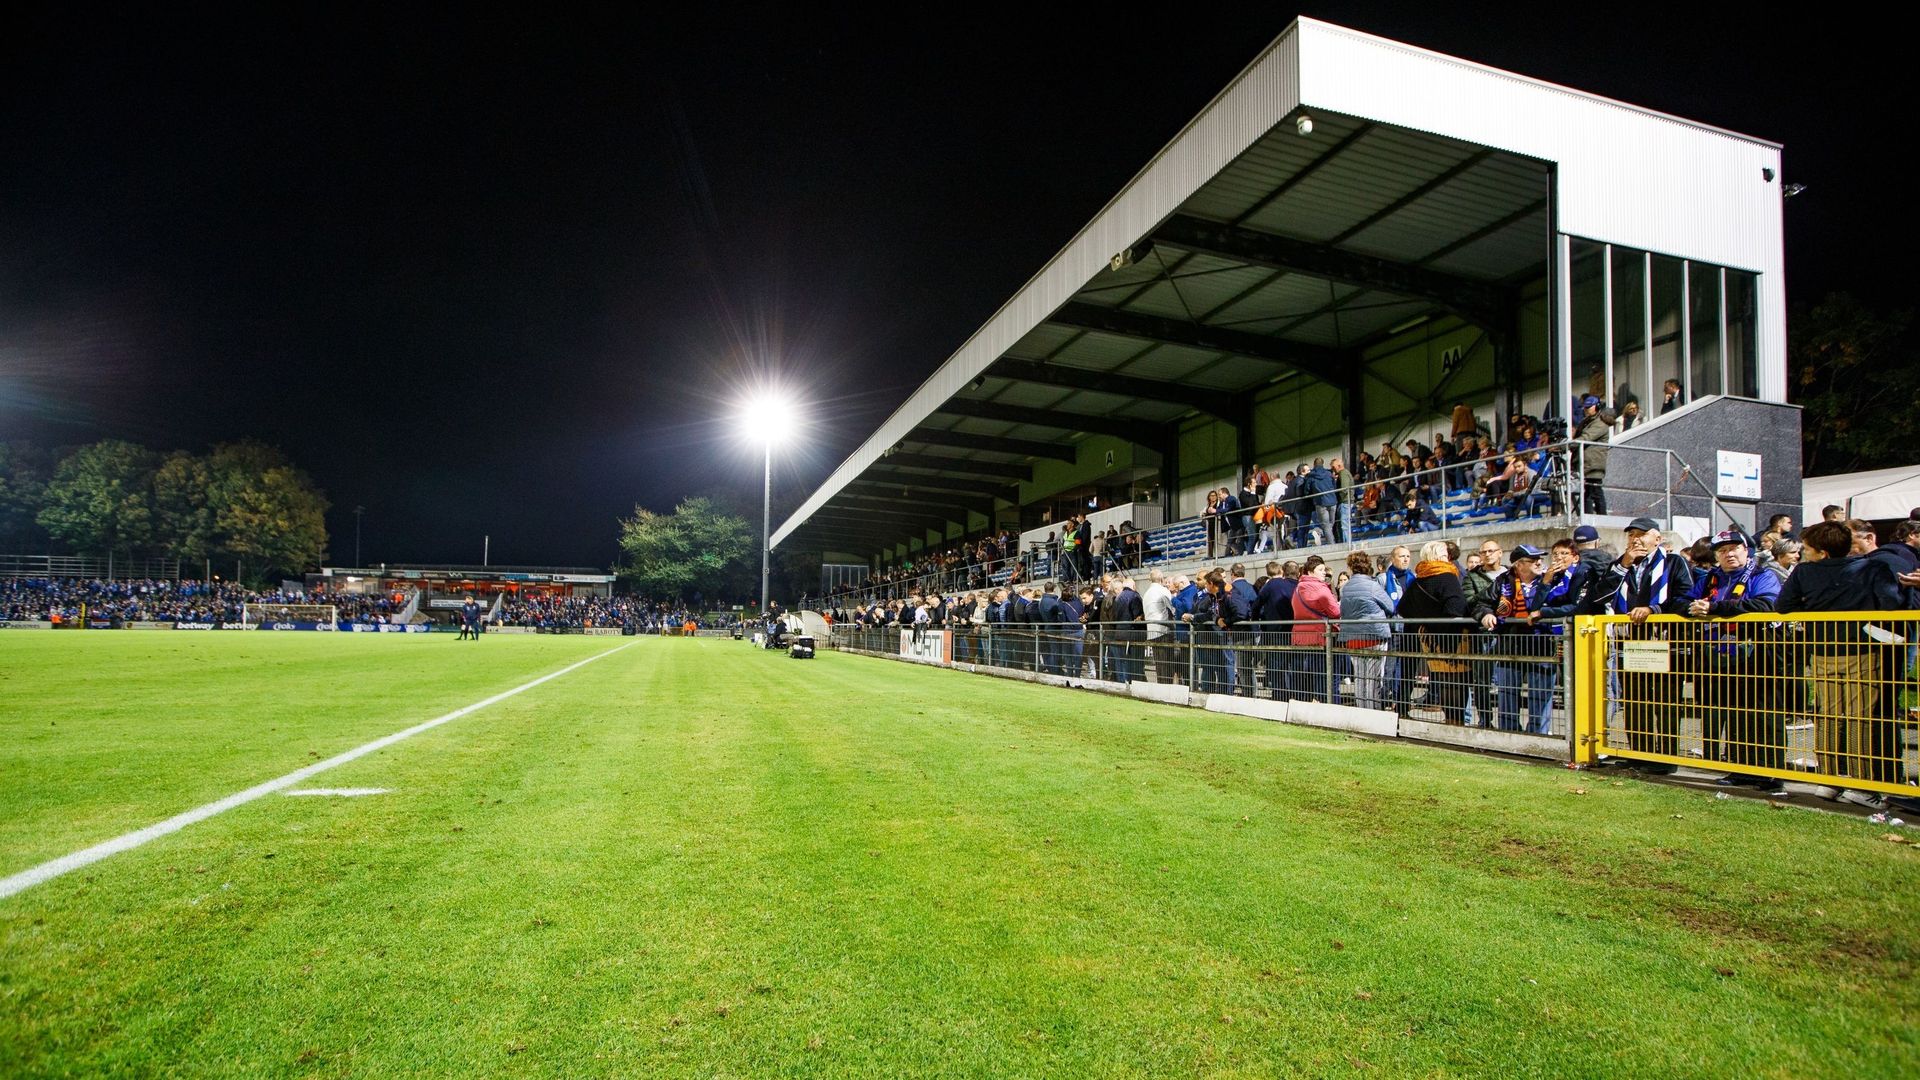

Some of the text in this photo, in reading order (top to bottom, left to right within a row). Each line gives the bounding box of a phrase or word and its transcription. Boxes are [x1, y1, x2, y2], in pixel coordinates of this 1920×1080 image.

[1442, 349, 1462, 373] AA
[1106, 451, 1113, 466] A
[1722, 485, 1732, 493] AA
[177, 621, 215, 631] betway
[222, 621, 259, 631] betay
